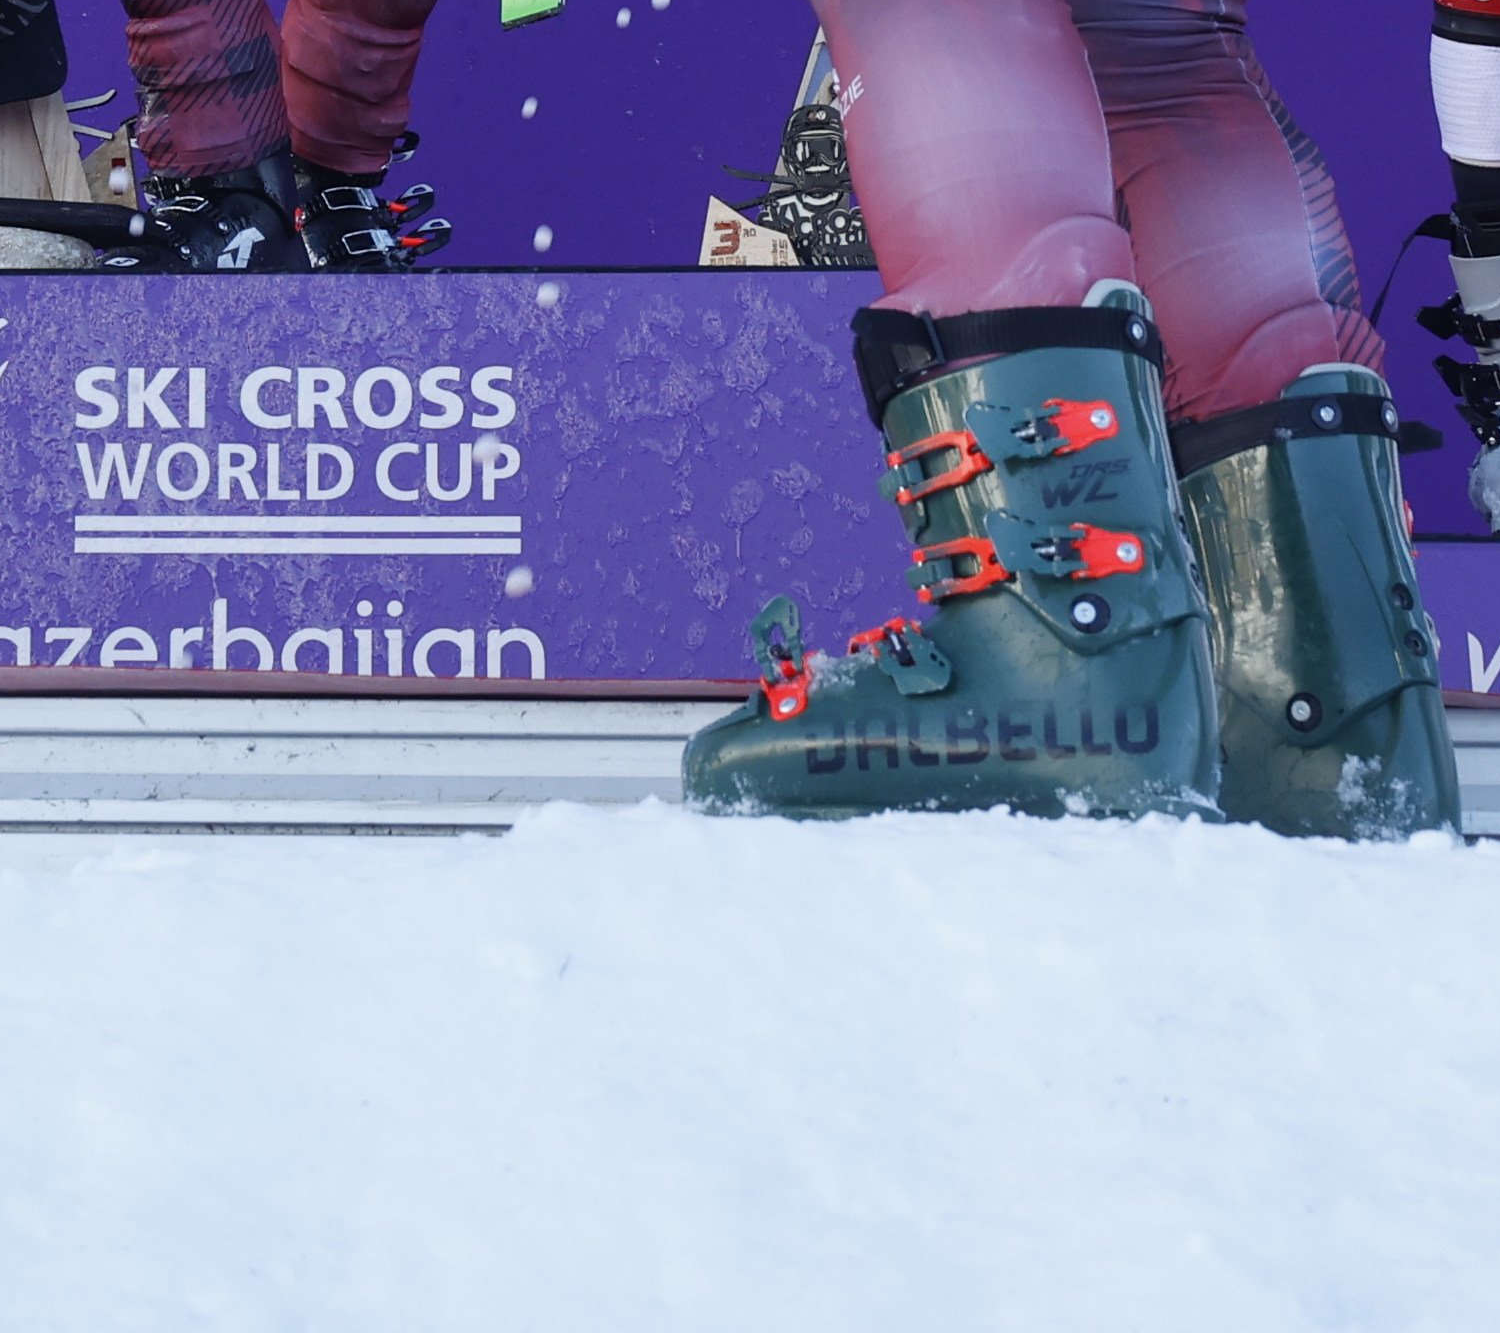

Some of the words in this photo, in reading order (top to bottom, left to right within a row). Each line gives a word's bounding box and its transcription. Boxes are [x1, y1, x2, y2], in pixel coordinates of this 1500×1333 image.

[75, 366, 209, 429] SKI
[239, 364, 517, 429] CROSS
[75, 442, 354, 501] WORLD
[375, 440, 522, 501] CUP
[804, 703, 1161, 776] DALBELLO
